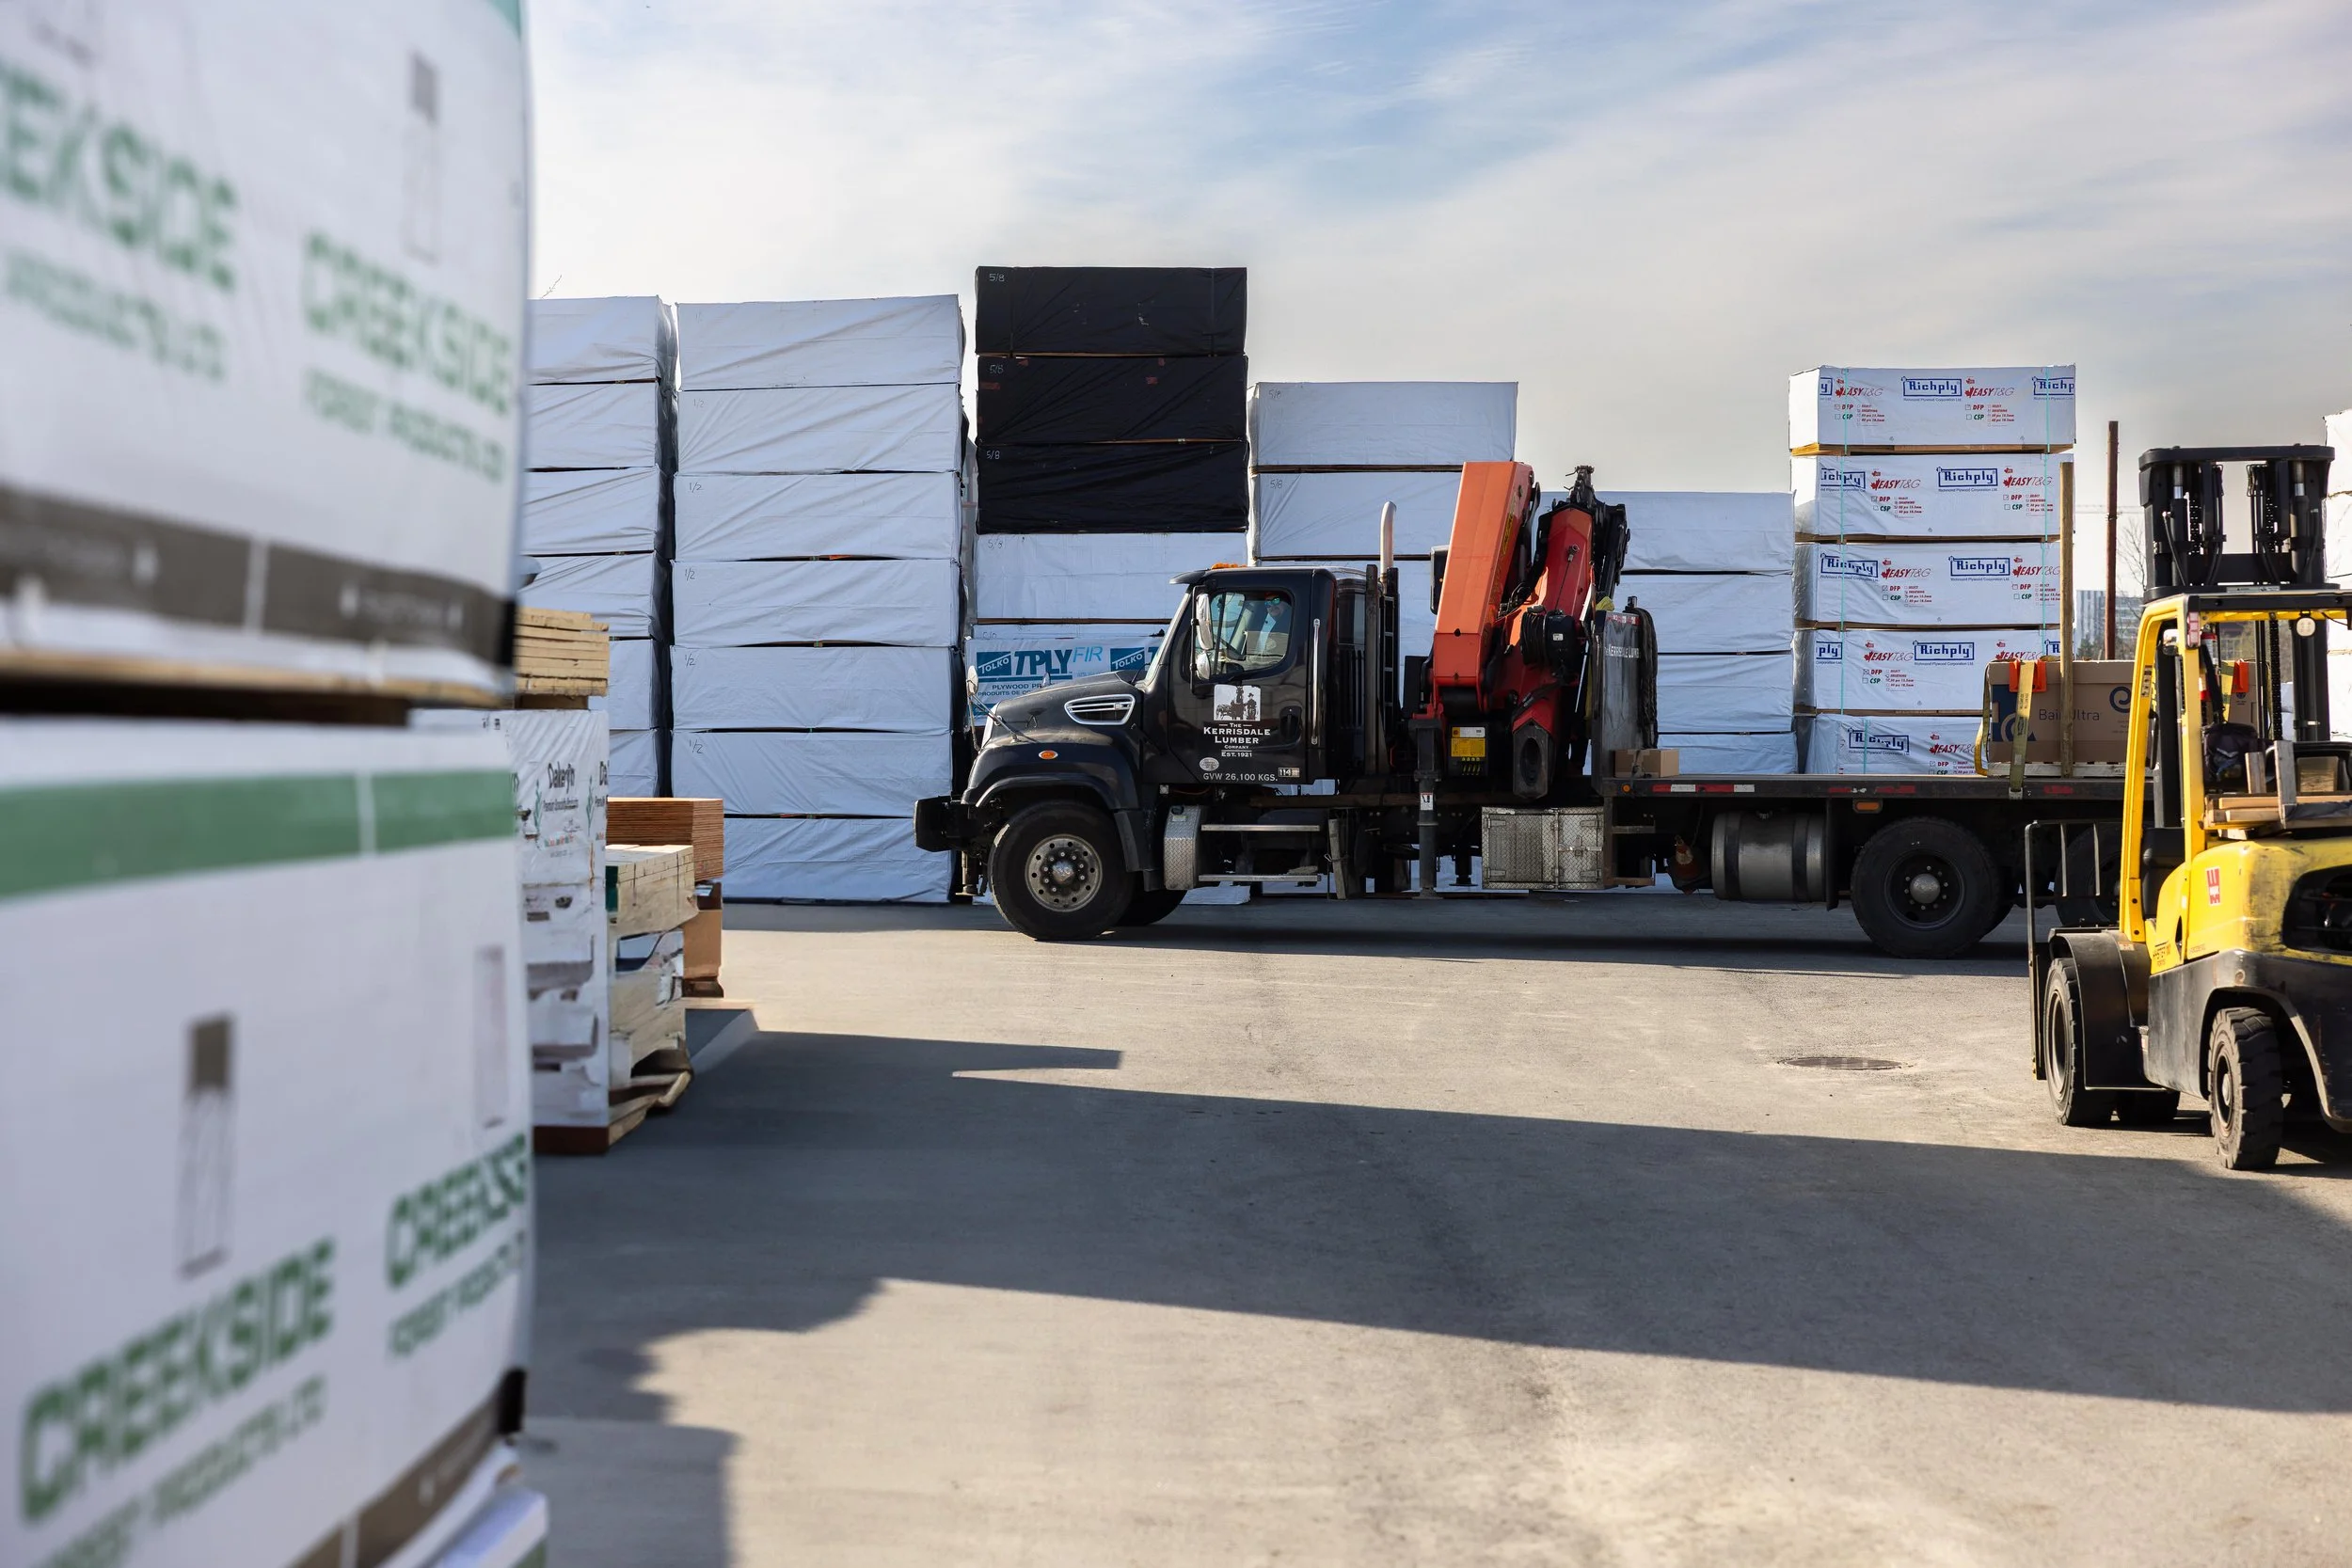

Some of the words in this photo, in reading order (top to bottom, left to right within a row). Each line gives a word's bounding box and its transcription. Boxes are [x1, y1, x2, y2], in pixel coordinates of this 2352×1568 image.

[988, 272, 1005, 282] 5/8
[1908, 380, 1958, 394] Richply
[1944, 470, 1994, 484] Richply
[689, 483, 703, 493] 1/2
[1270, 479, 1283, 489] 5/8
[1957, 560, 2006, 573] Richply
[685, 568, 696, 581] 1/2
[1920, 644, 1970, 657] Richply
[685, 653, 696, 666] 1/2
[979, 657, 1009, 674] TOLKO
[1073, 645, 1104, 663] FIR
[1112, 653, 1143, 670] TOLKO
[1203, 726, 1271, 736] KERRISDALE
[689, 739, 704, 753] 1/2
[1215, 736, 1259, 744] LUMBER
[1225, 773, 1256, 782] 26,100
[1258, 773, 1279, 782] KGS.
[21, 1237, 335, 1526] CREEKSIDE
